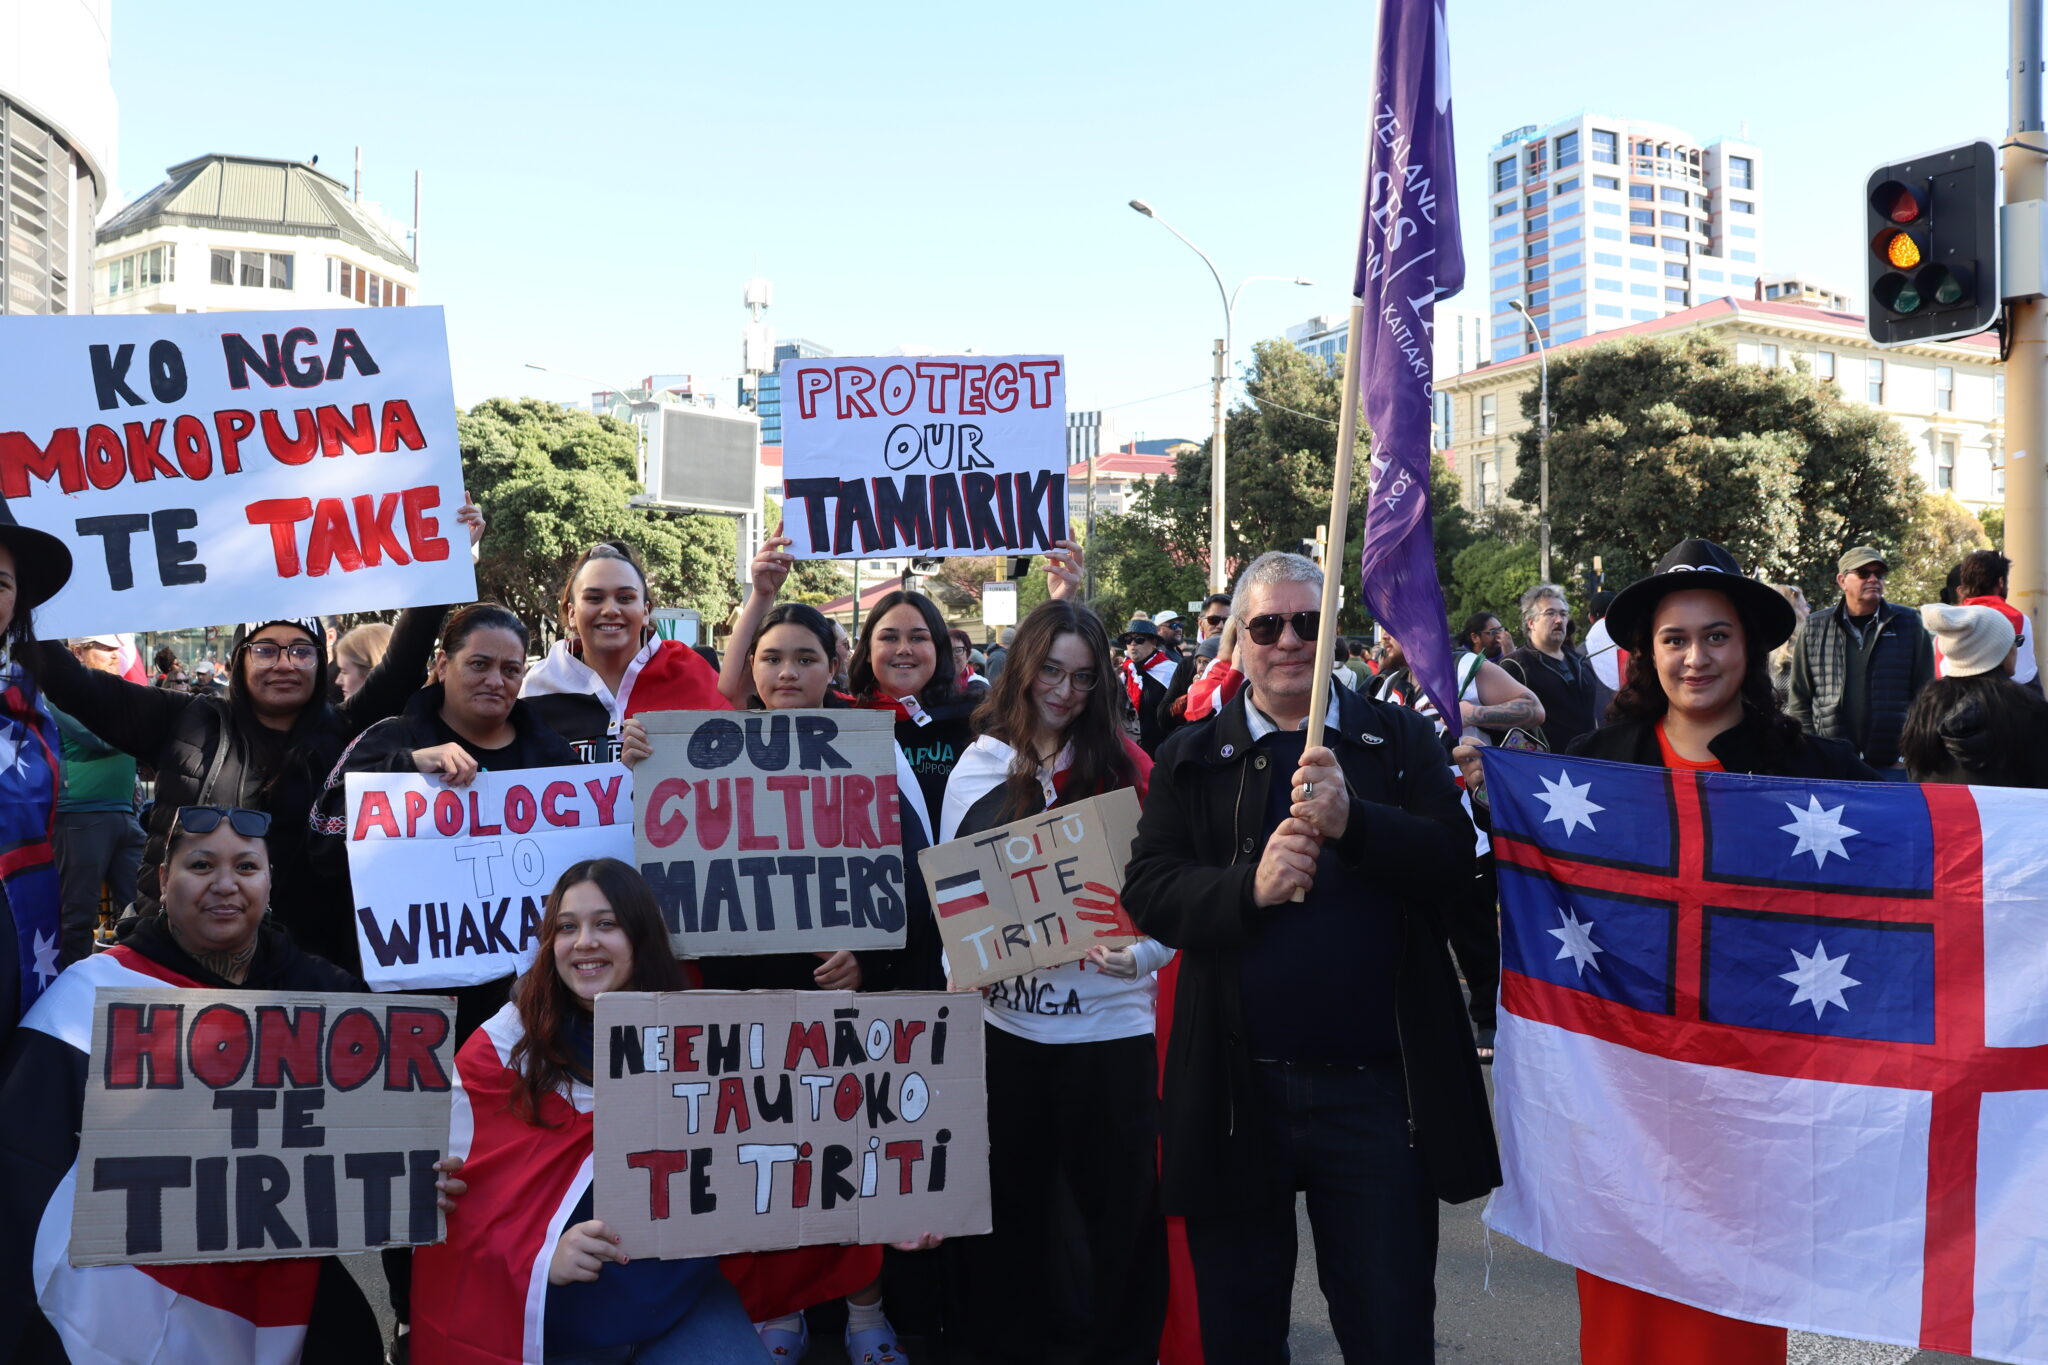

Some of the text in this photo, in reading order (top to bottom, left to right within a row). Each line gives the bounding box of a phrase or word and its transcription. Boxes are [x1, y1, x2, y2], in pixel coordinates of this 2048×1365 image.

[89, 327, 380, 410] KO NGA
[1382, 302, 1430, 379] KAITIAKI
[797, 360, 1061, 420] PROTECT
[0, 399, 427, 499] MOKOPUNA
[884, 423, 994, 472] OUR
[75, 485, 450, 591] TE TAKE
[784, 469, 1067, 555] TAMARIKI
[687, 715, 852, 771] OUR
[352, 774, 624, 841] APOLOGY
[644, 774, 902, 852] CULTURE
[454, 838, 545, 898] TO
[641, 854, 906, 934] MATTERS
[1011, 856, 1083, 903] TE
[357, 894, 552, 967] WHAKA
[961, 912, 1069, 970] TIRITI
[104, 1003, 452, 1092] HONOR
[609, 1023, 765, 1079] NEEHI
[213, 1089, 326, 1149] TE
[672, 1071, 930, 1134] TAUTOKO
[93, 1150, 441, 1255] TIRITI
[626, 1147, 717, 1220] TE
